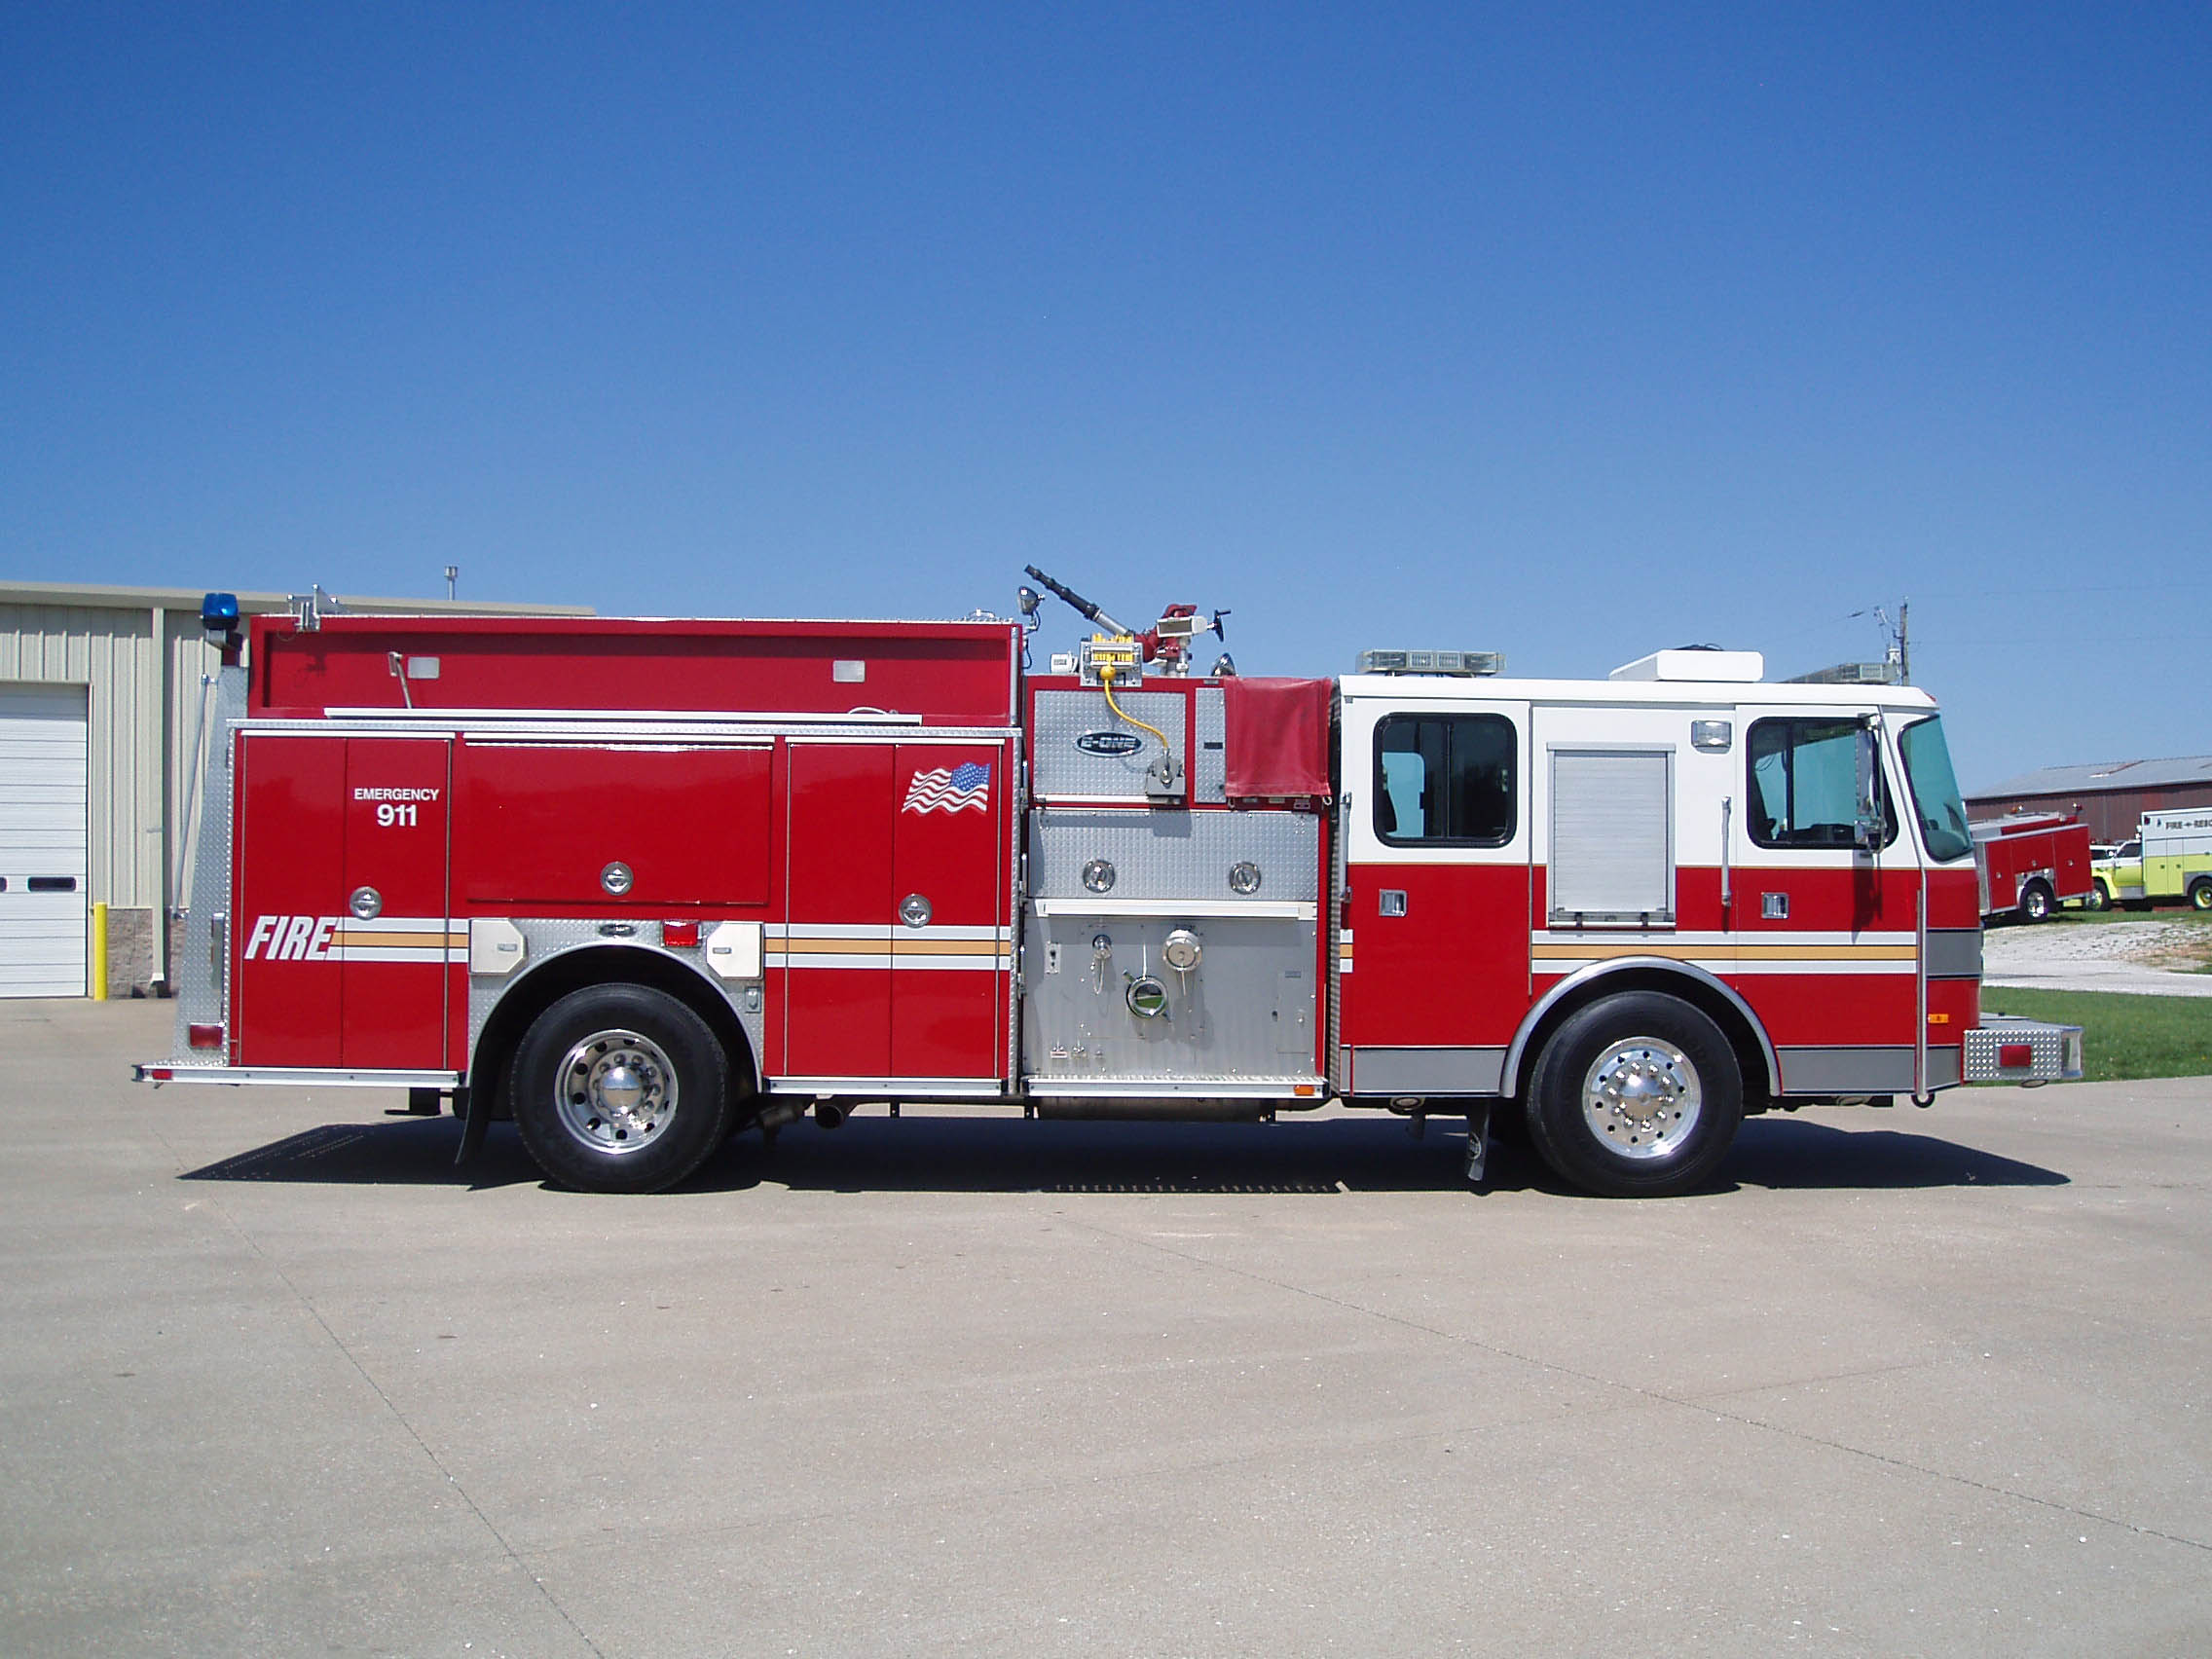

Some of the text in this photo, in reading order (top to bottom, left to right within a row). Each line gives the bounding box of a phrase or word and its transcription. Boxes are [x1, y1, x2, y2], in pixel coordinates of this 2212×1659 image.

[1081, 737, 1137, 749] E-ONE
[354, 788, 439, 801] EMERGENCY
[377, 803, 417, 827] 911
[243, 915, 339, 961] FIRE
